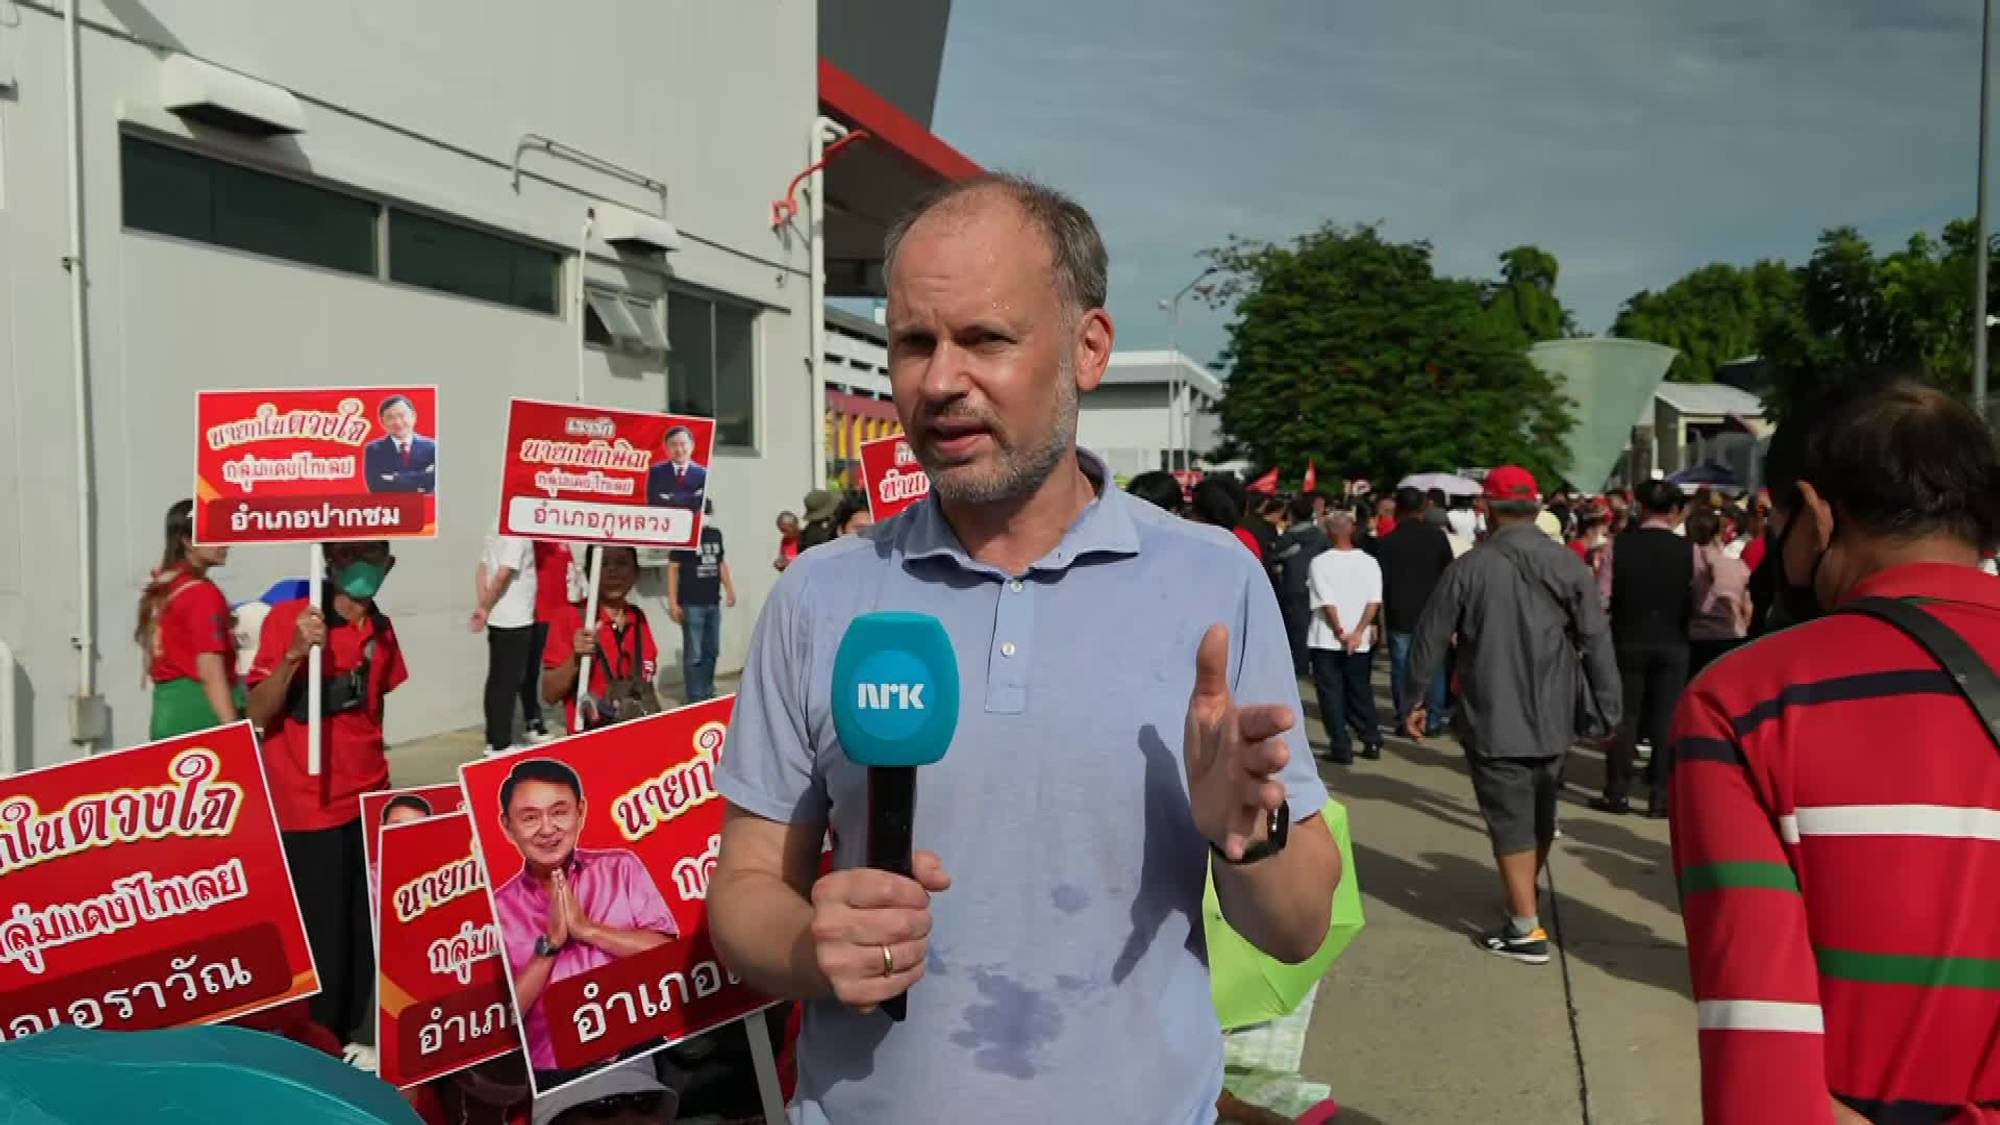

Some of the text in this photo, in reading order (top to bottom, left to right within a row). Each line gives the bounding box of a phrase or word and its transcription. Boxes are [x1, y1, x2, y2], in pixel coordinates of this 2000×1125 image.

[231, 502, 400, 531] อำเภอปากชม
[533, 502, 671, 538] อำเภอภูหลวง
[394, 850, 487, 922] นายก
[0, 859, 248, 973] ลุ่มแดงไทเลย
[419, 1002, 517, 1055] อำเภ
